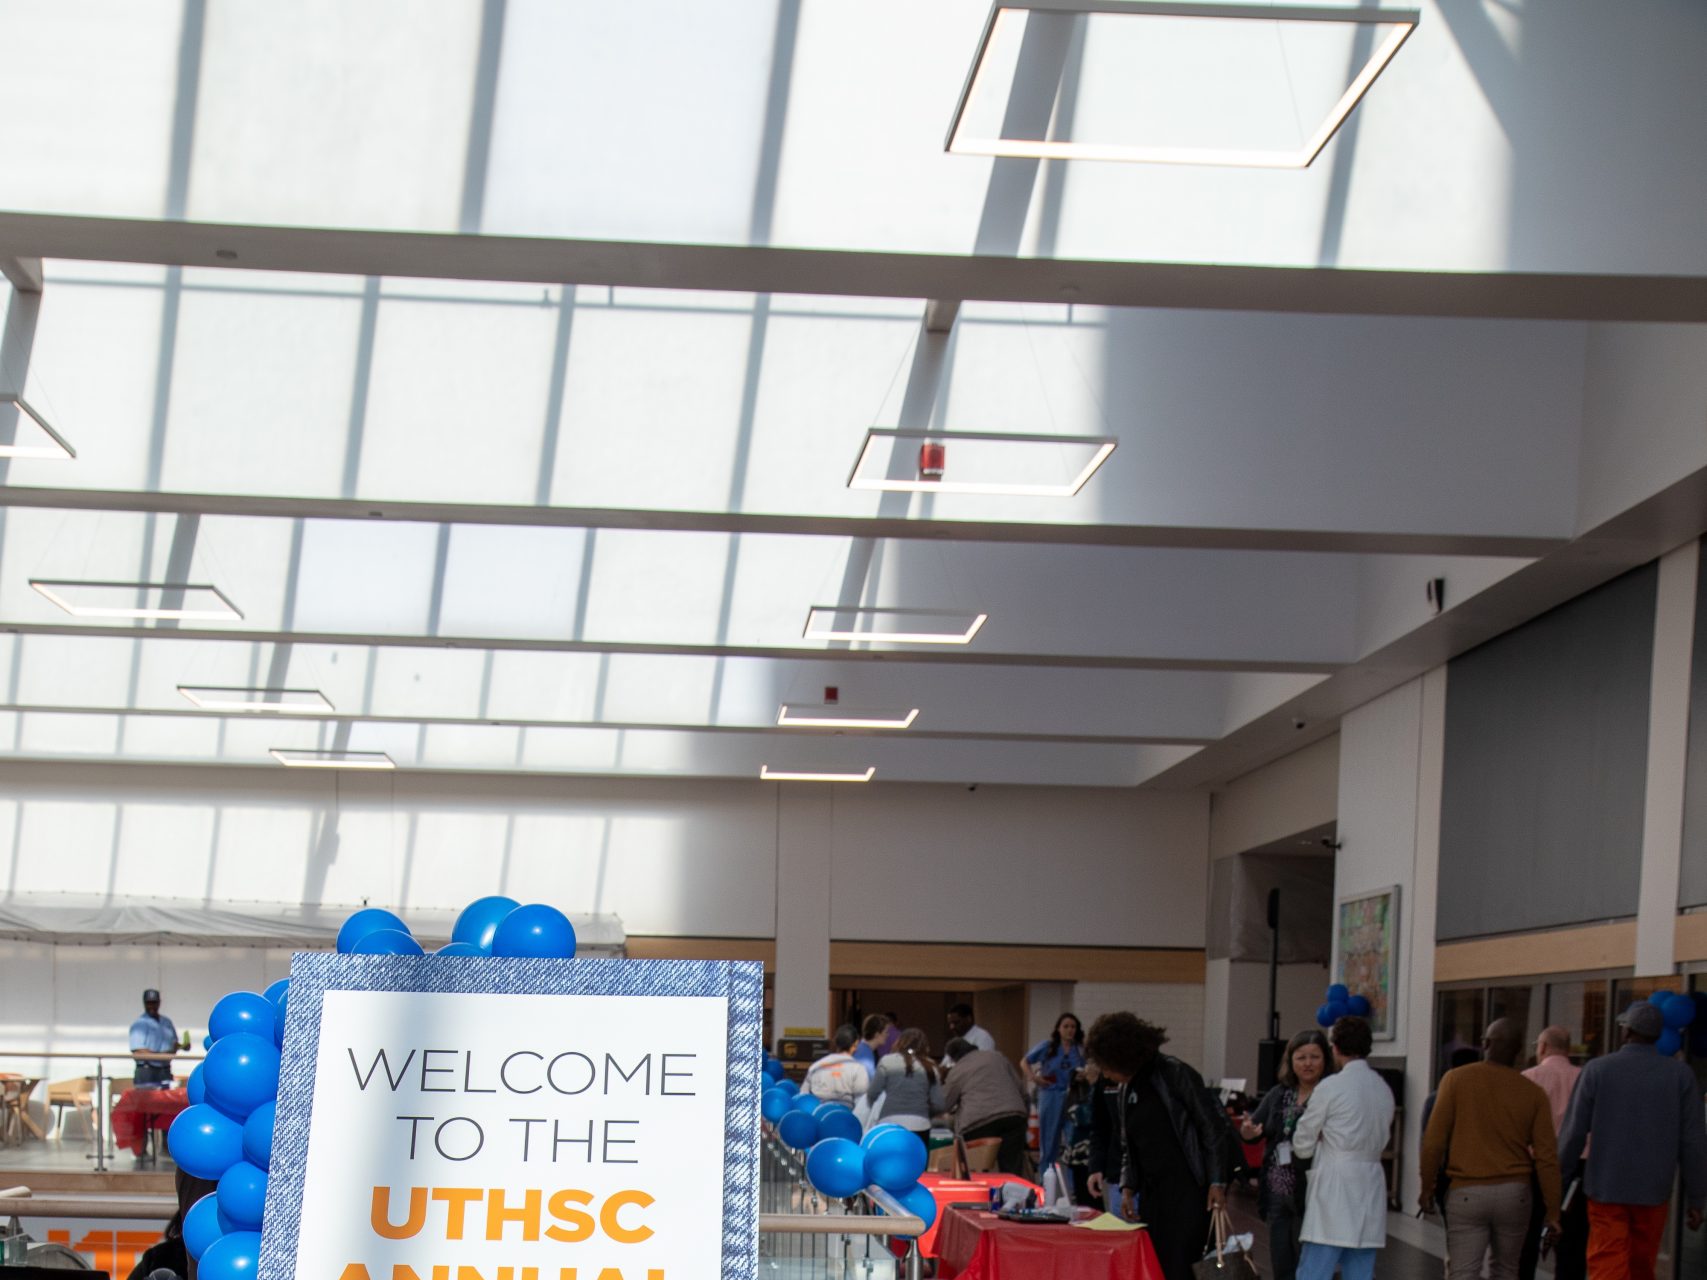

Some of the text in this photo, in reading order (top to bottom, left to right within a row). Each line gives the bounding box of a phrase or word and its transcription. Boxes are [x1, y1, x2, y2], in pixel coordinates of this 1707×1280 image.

[348, 1047, 698, 1096] WELCOME
[396, 1116, 640, 1164] TO THE
[370, 1186, 656, 1245] UTHSC
